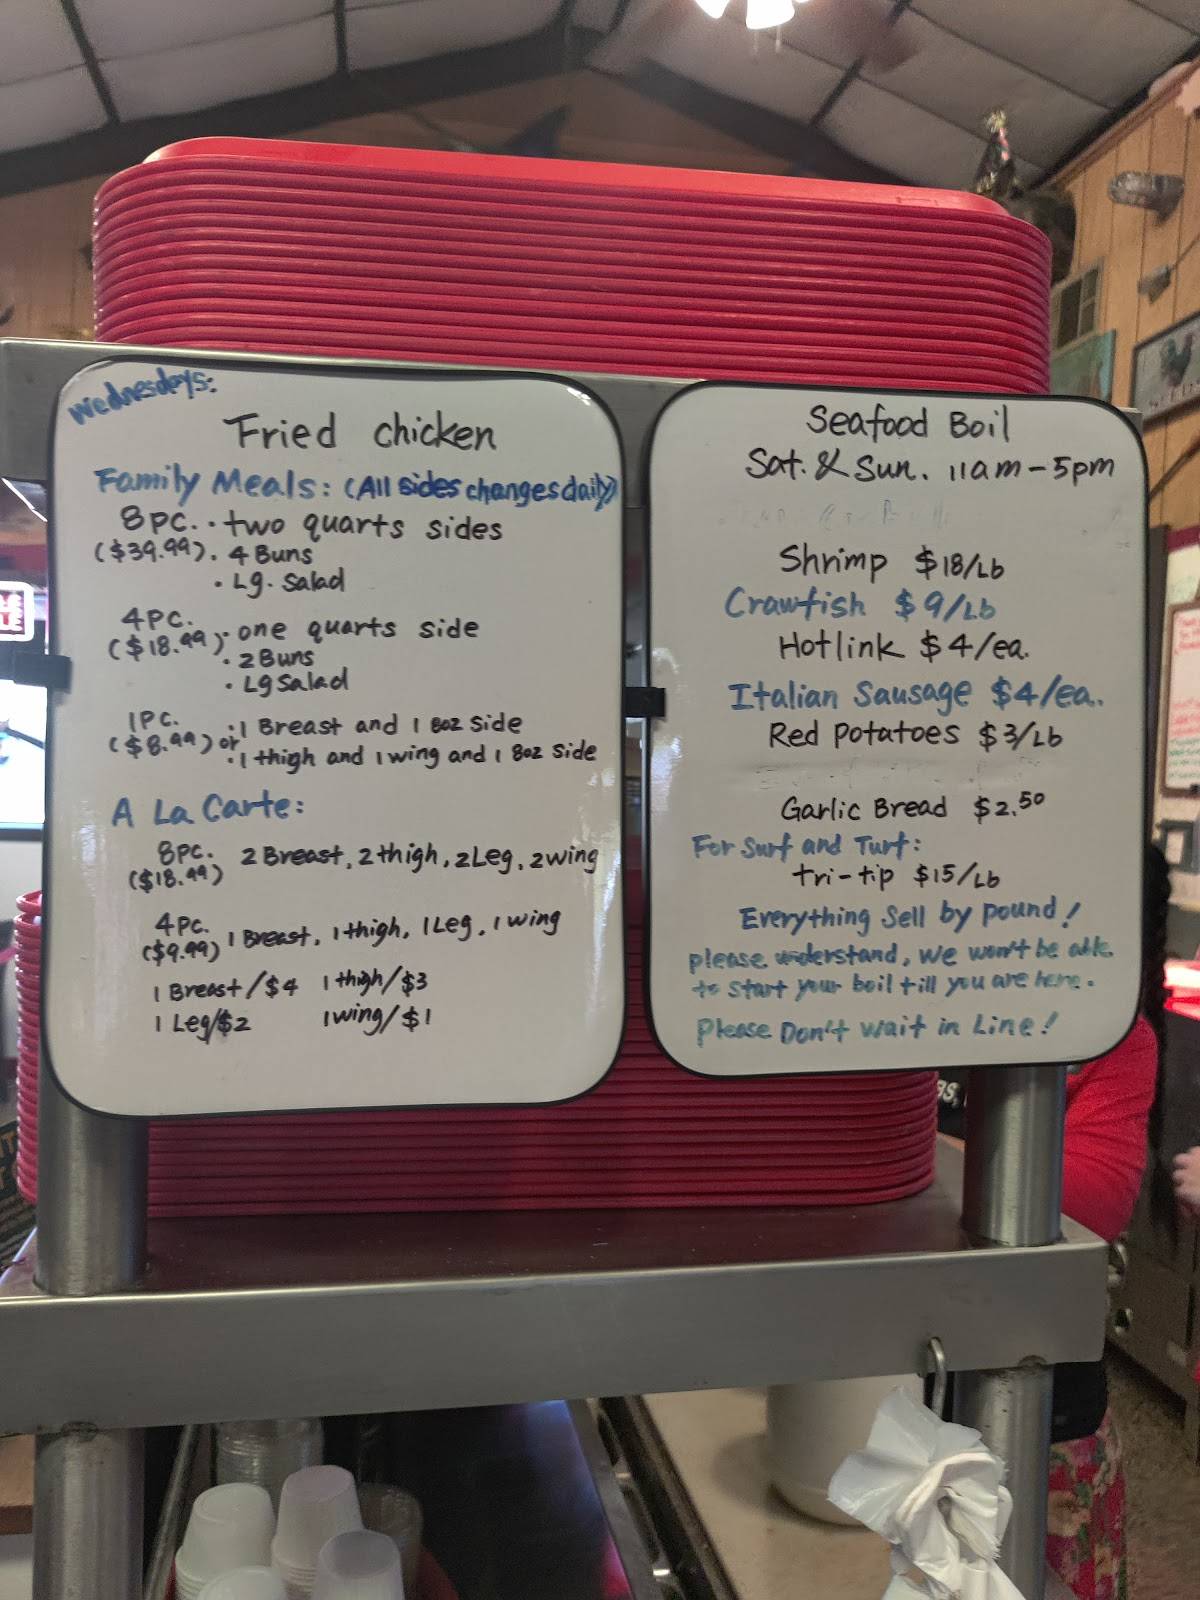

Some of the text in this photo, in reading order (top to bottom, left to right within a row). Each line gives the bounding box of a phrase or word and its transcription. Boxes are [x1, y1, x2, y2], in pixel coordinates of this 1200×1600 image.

[223, 412, 337, 449] Fried
[806, 403, 1009, 443] Seafood Boil
[745, 448, 806, 480] Sat.
[815, 448, 849, 480] &
[854, 455, 928, 482] Sun.
[94, 462, 200, 507] Family
[212, 468, 331, 499] Meals:
[345, 475, 390, 500] (All
[223, 510, 285, 537] two
[303, 513, 404, 542] quarts
[780, 543, 888, 584] Shrimp
[725, 586, 866, 621] Crawfish
[238, 622, 287, 640] one
[308, 616, 396, 644] quarts
[728, 680, 838, 711] Italian
[854, 680, 972, 717] Sausage
[258, 717, 342, 735] Breast
[356, 713, 398, 735] and
[770, 719, 818, 748] Red
[253, 747, 315, 775] thigh
[327, 745, 364, 765] and
[389, 745, 440, 769] wing
[448, 744, 486, 763] and
[112, 789, 304, 827] A La Carte:
[781, 796, 861, 821] Garlic
[874, 795, 947, 819] Bread
[692, 834, 735, 859] For
[802, 833, 841, 856] and
[508, 910, 561, 936] wing
[739, 905, 870, 937] Everything
[940, 900, 972, 933] by
[919, 945, 957, 966] we
[1036, 937, 1059, 958] be
[692, 980, 721, 998] to
[852, 973, 893, 994] boil
[945, 976, 984, 997] you
[992, 972, 1029, 988] are
[938, 1017, 960, 1036] in
